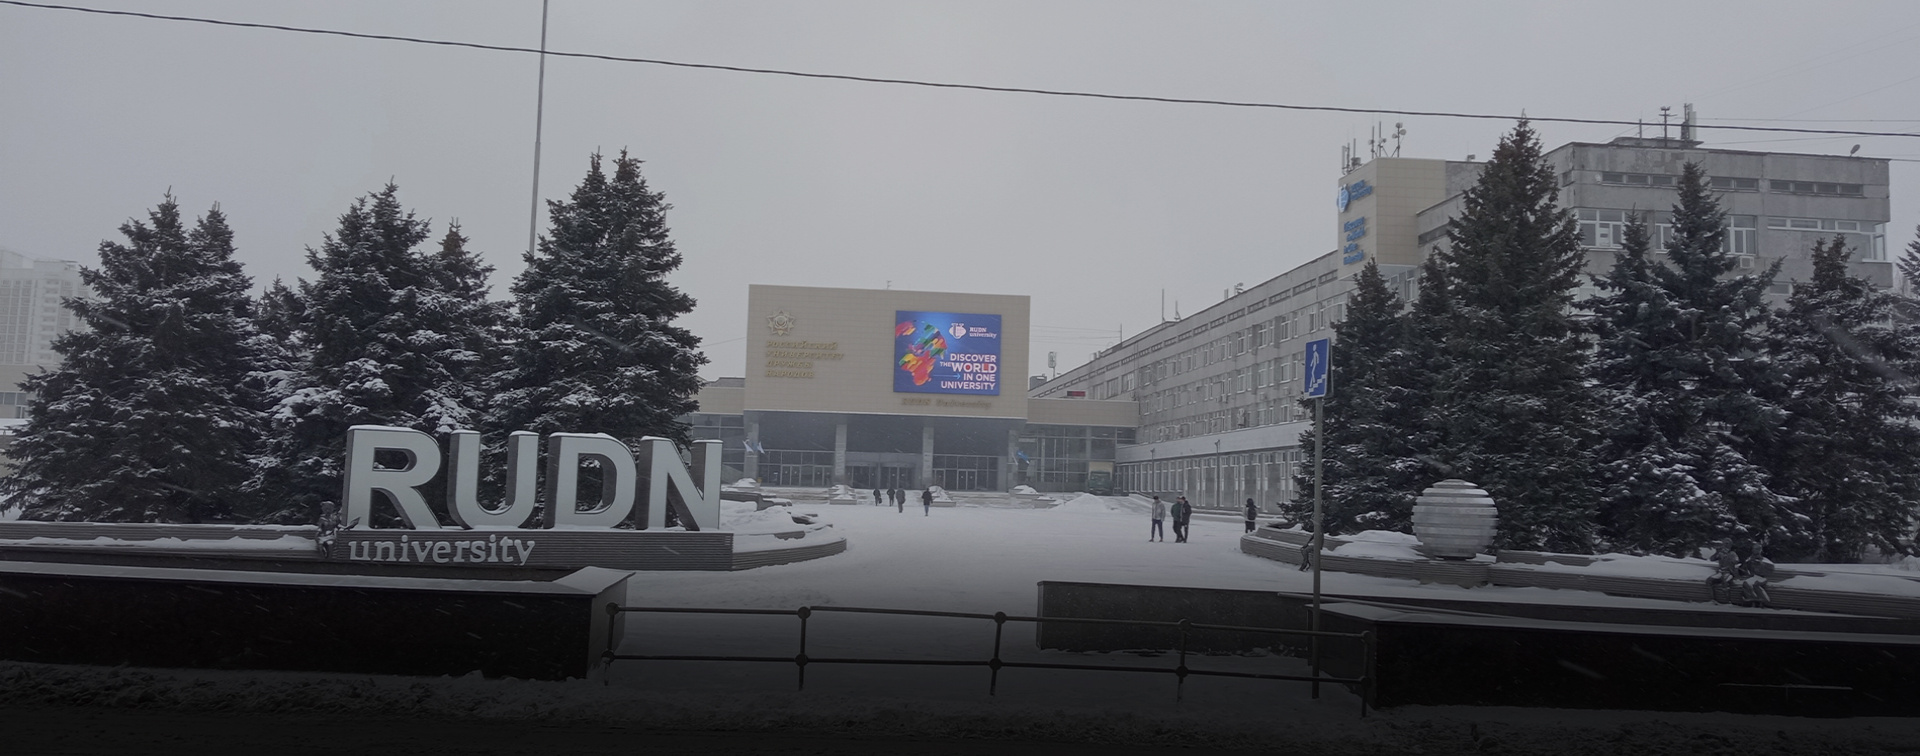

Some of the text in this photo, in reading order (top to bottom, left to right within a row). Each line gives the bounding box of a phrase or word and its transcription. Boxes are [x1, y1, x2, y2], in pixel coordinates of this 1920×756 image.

[766, 350, 844, 360] УНИВЕРСИТЕТ
[950, 353, 997, 362] DISCOVER
[766, 360, 813, 369] ДРУЖБЫ
[951, 362, 997, 373] WORLD
[765, 369, 814, 378] НАРОДОВ
[963, 373, 996, 382] IN ONE
[941, 381, 996, 390] UNIVERSITY
[343, 425, 723, 531] RUDN
[348, 535, 535, 566] university
